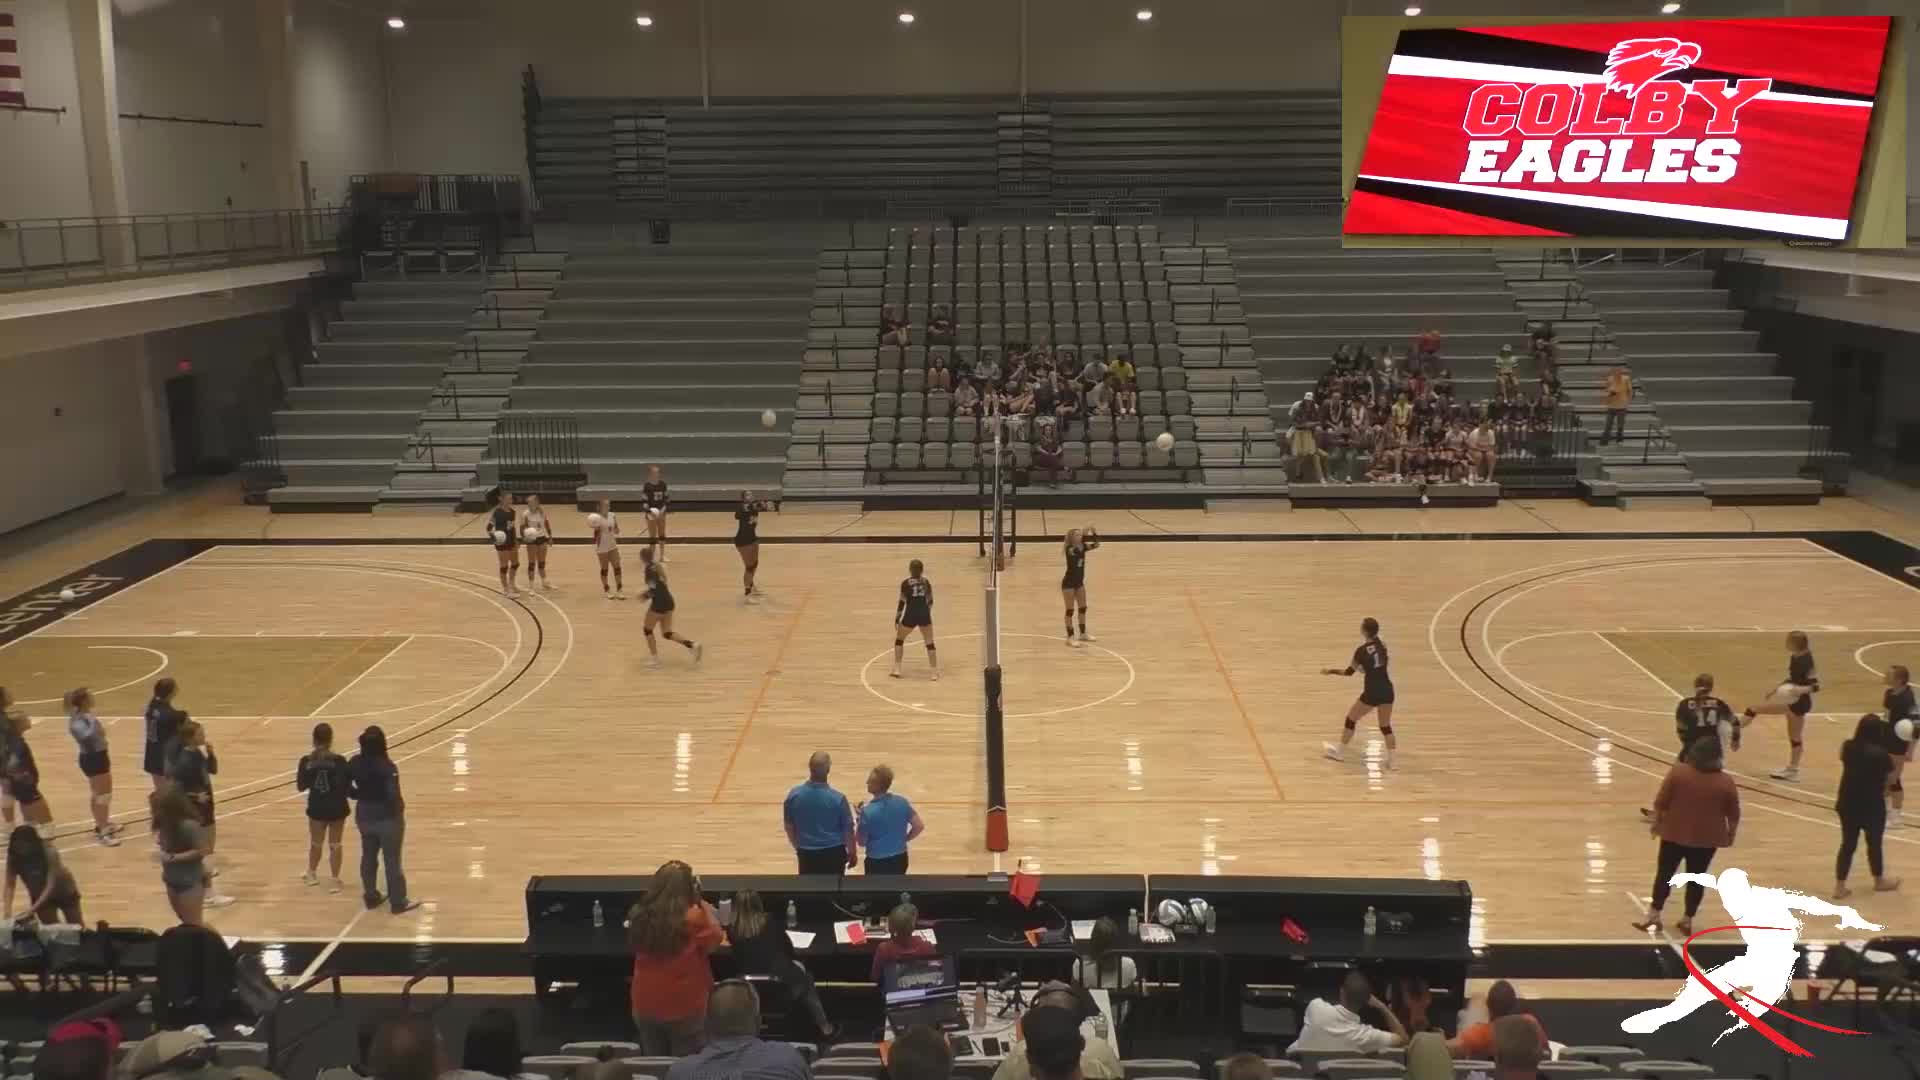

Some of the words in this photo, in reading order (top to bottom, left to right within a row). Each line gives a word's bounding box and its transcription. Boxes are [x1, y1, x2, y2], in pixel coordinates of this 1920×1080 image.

[1462, 77, 1772, 136] COLBY
[1459, 138, 1742, 183] EAGLES
[1696, 710, 1718, 727] 14
[314, 769, 331, 793] 4
